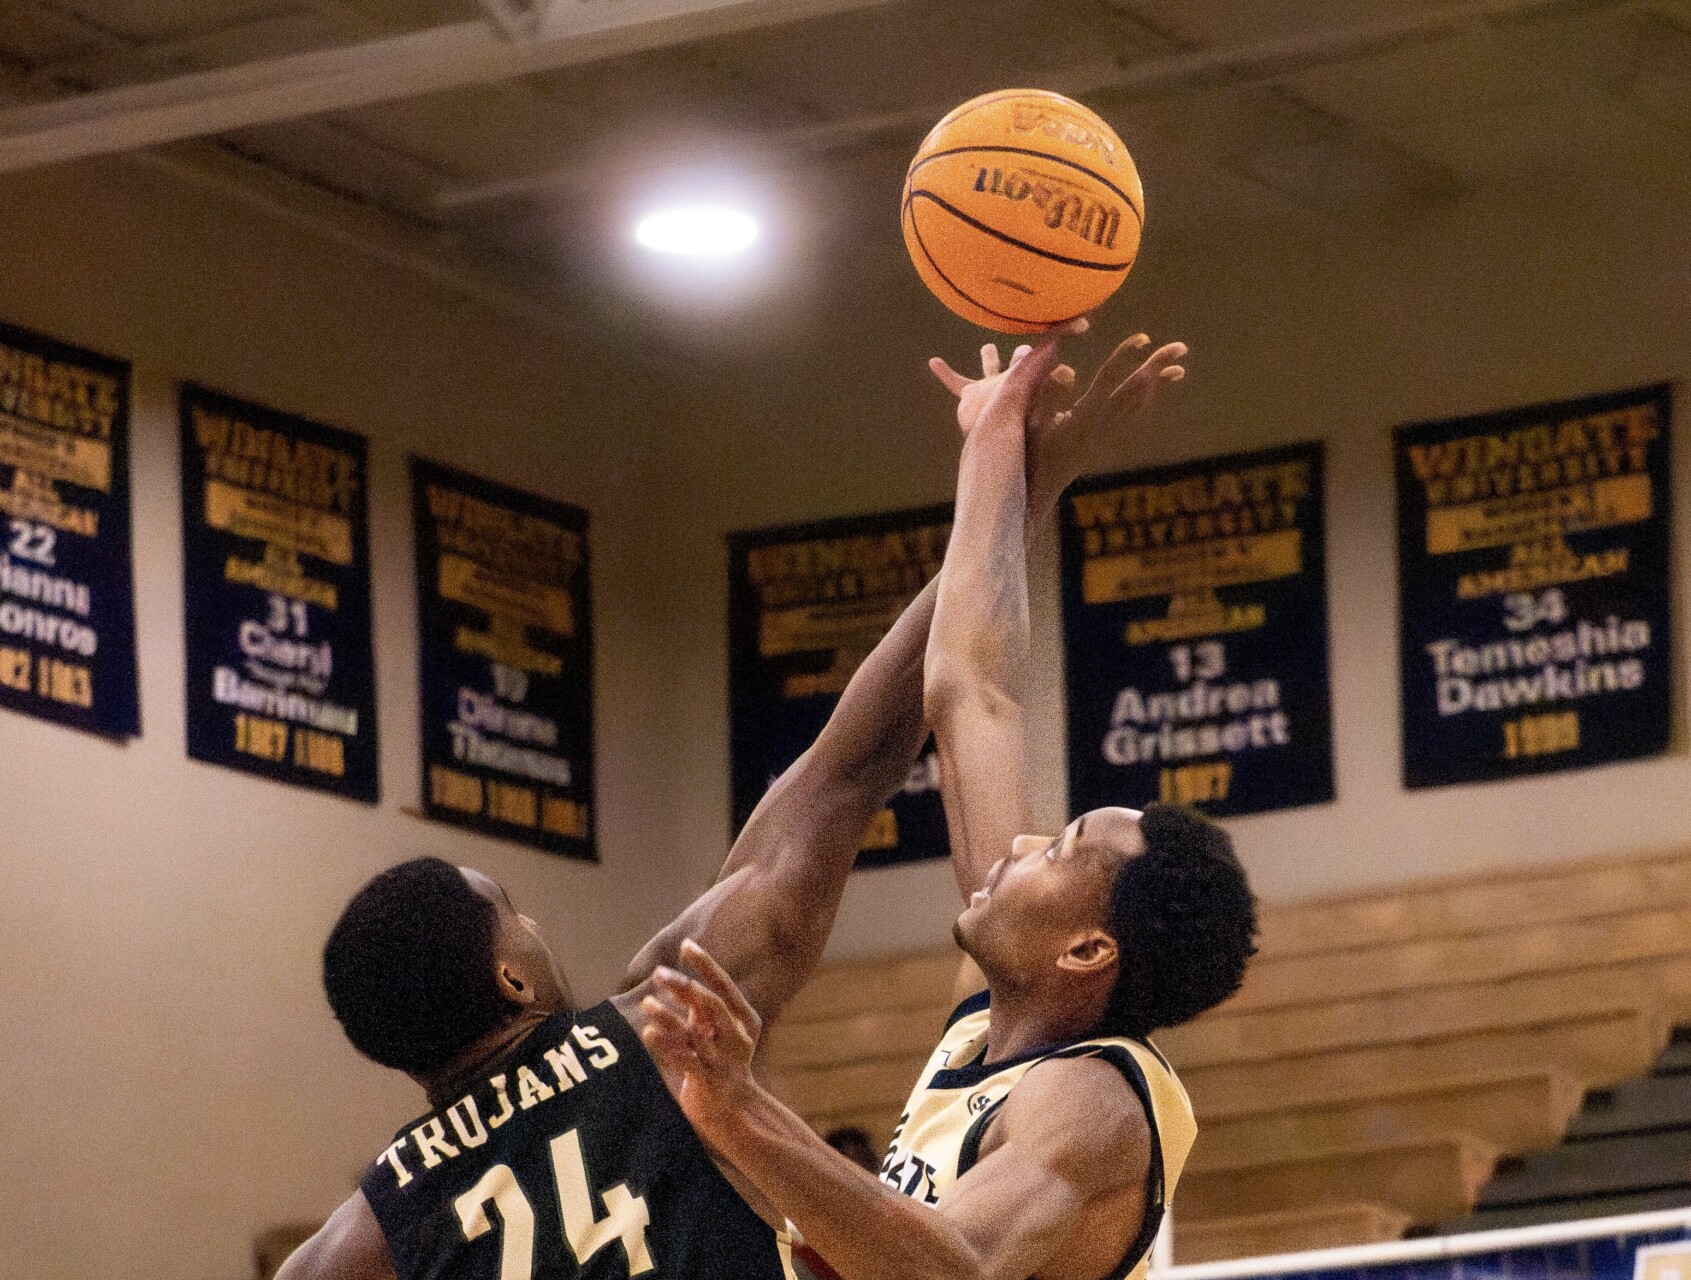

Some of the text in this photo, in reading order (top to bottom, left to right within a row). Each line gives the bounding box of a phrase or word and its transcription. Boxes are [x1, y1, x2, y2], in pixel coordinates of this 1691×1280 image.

[971, 165, 1121, 251] Wilson
[9, 523, 57, 567] 22
[0, 604, 98, 656] onroe
[1501, 588, 1567, 634] 34
[1168, 641, 1227, 682] 13
[1436, 657, 1647, 718] Dawkins
[1101, 711, 1292, 766] Grissett
